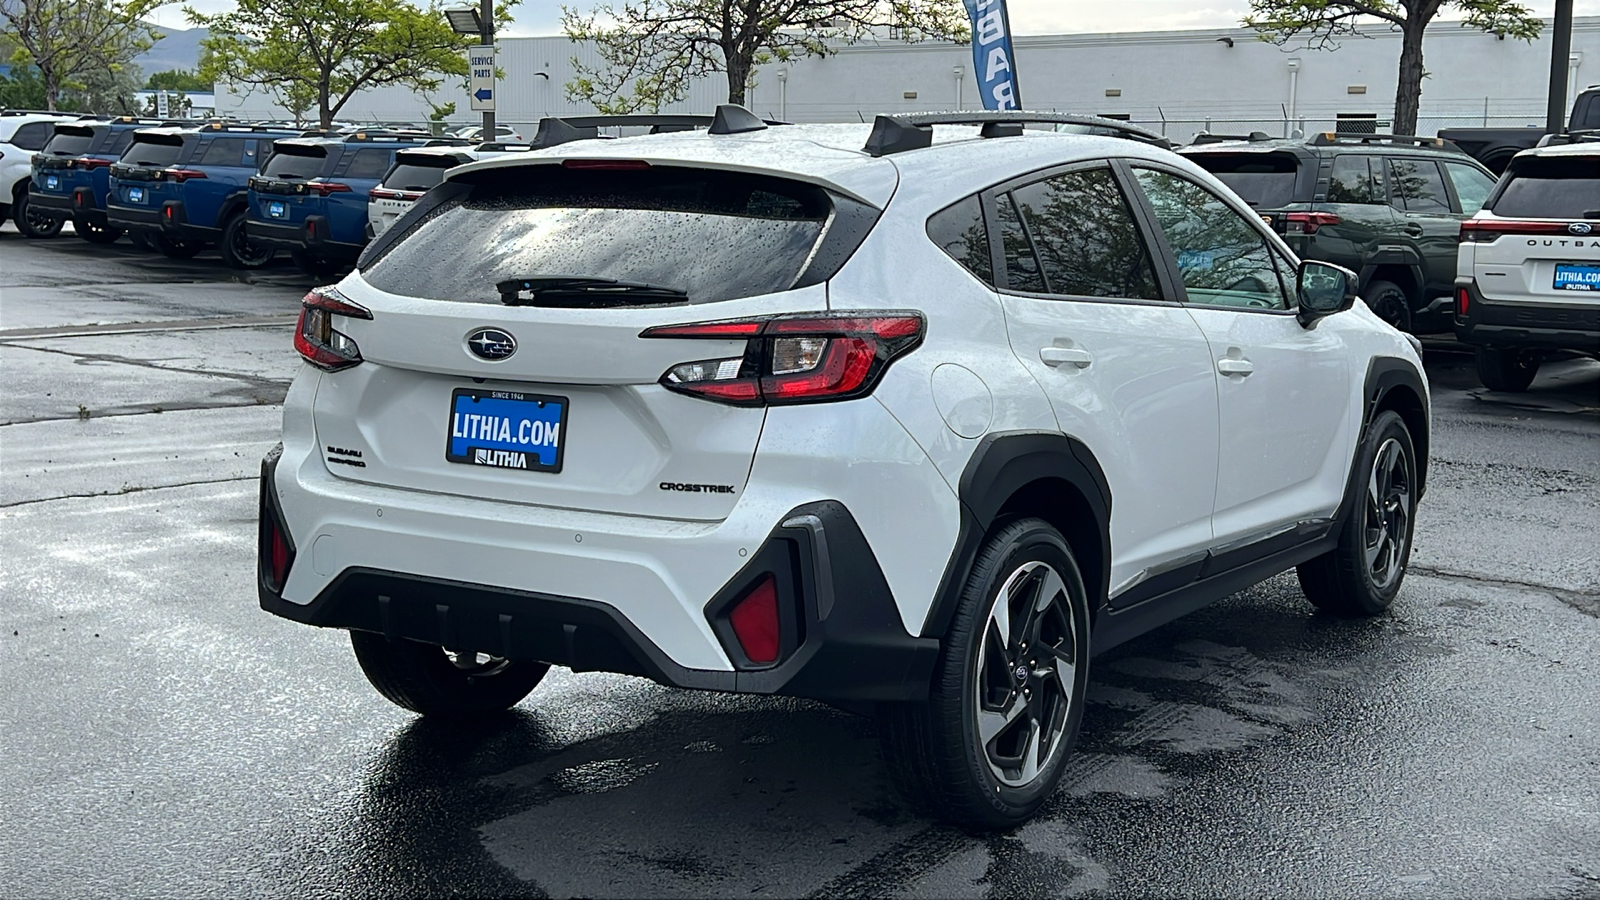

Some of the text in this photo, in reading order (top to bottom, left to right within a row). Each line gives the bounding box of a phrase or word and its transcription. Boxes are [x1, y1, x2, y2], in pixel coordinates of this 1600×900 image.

[471, 56, 493, 66] SERVICE
[474, 69, 491, 78] PARTS
[492, 391, 524, 401] SINCE 1946
[453, 412, 560, 448] LITHIA.COM
[327, 446, 362, 458] SUBARU
[487, 449, 527, 469] LITHIA
[659, 482, 736, 494] CROSSTREK
